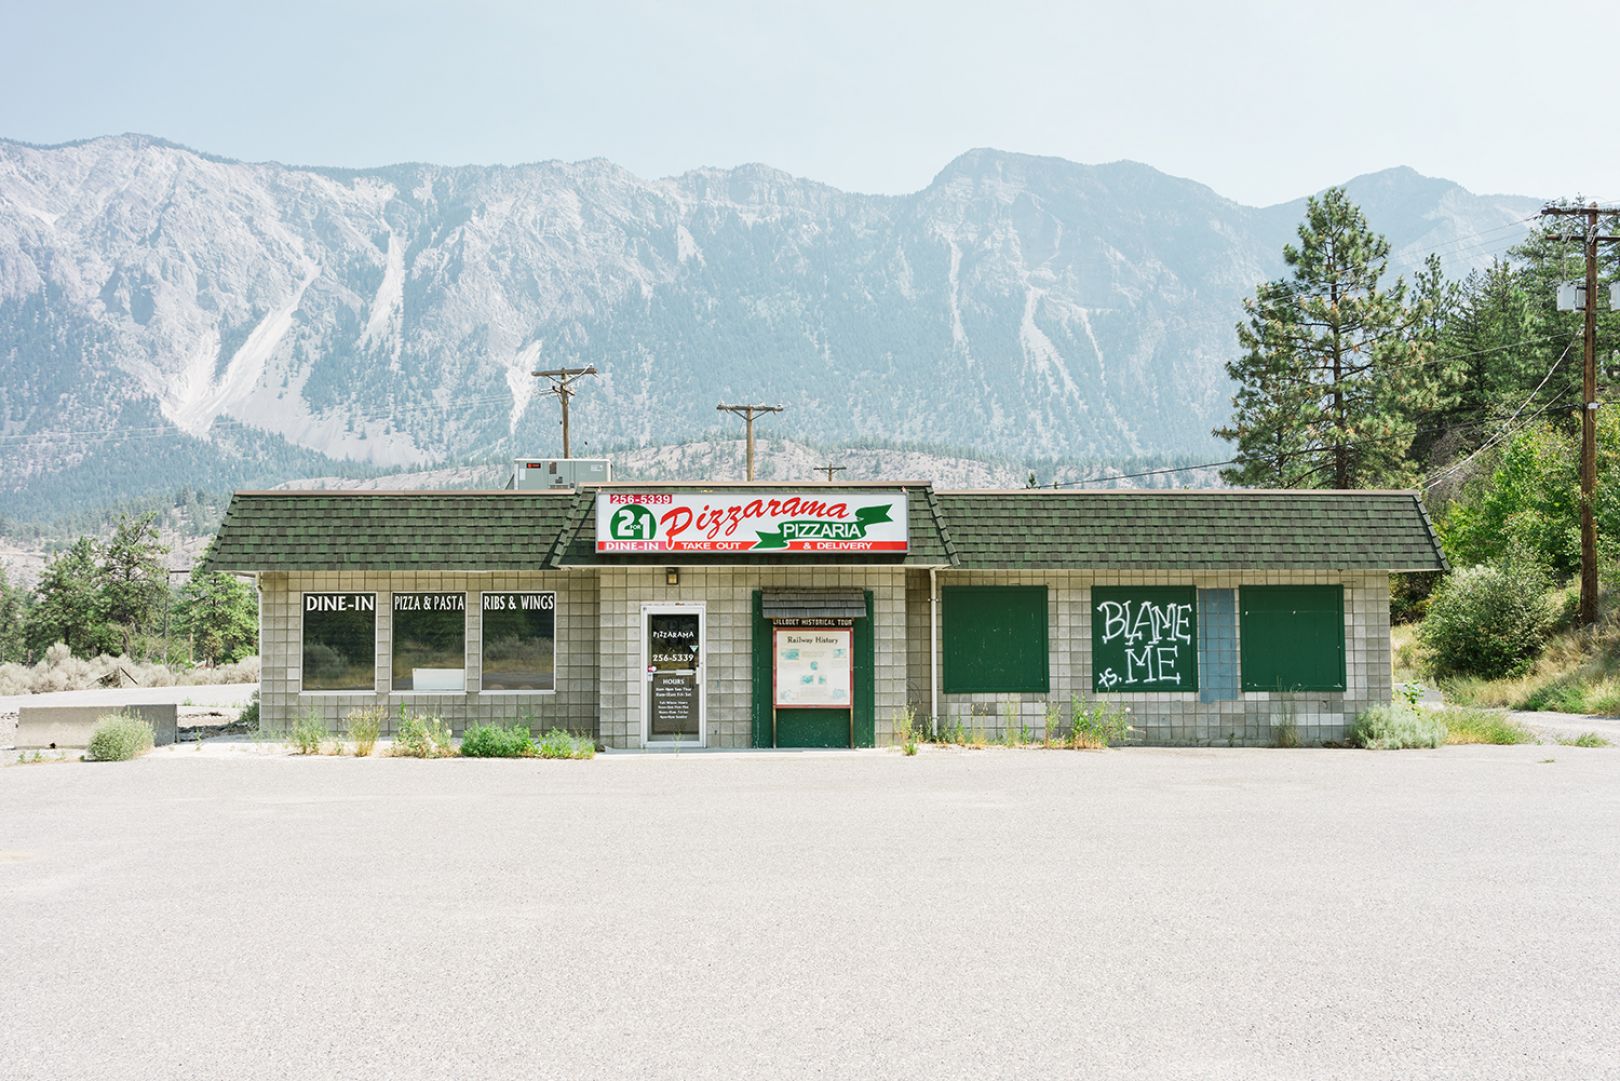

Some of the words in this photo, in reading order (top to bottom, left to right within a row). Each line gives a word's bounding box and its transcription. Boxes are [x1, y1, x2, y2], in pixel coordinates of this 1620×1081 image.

[611, 494, 671, 504] 256-5339
[617, 509, 635, 537] 2
[638, 513, 651, 540] 1
[659, 496, 850, 548] Pizzarama
[782, 523, 862, 538] PIZZARIA
[605, 541, 660, 551] DINE-IN
[681, 541, 712, 550] TAKE
[716, 541, 742, 550] OUT
[802, 541, 812, 550] &
[816, 541, 873, 550] DELIVERY
[306, 596, 375, 611] DINE-IN
[394, 595, 421, 610] PIZZA
[423, 595, 432, 610] &
[433, 595, 465, 610] PASTA
[483, 595, 506, 610] RIBS
[508, 595, 517, 610] &
[520, 595, 554, 610] WINGS
[801, 618, 835, 626] HISTORICAL
[837, 618, 853, 626] TOUR
[1096, 599, 1193, 646] BLAME
[653, 631, 695, 639] PIZZARAMA
[787, 636, 814, 645] Railway
[815, 636, 839, 645] History
[652, 653, 695, 662] 256-5339
[1124, 645, 1182, 685] ME
